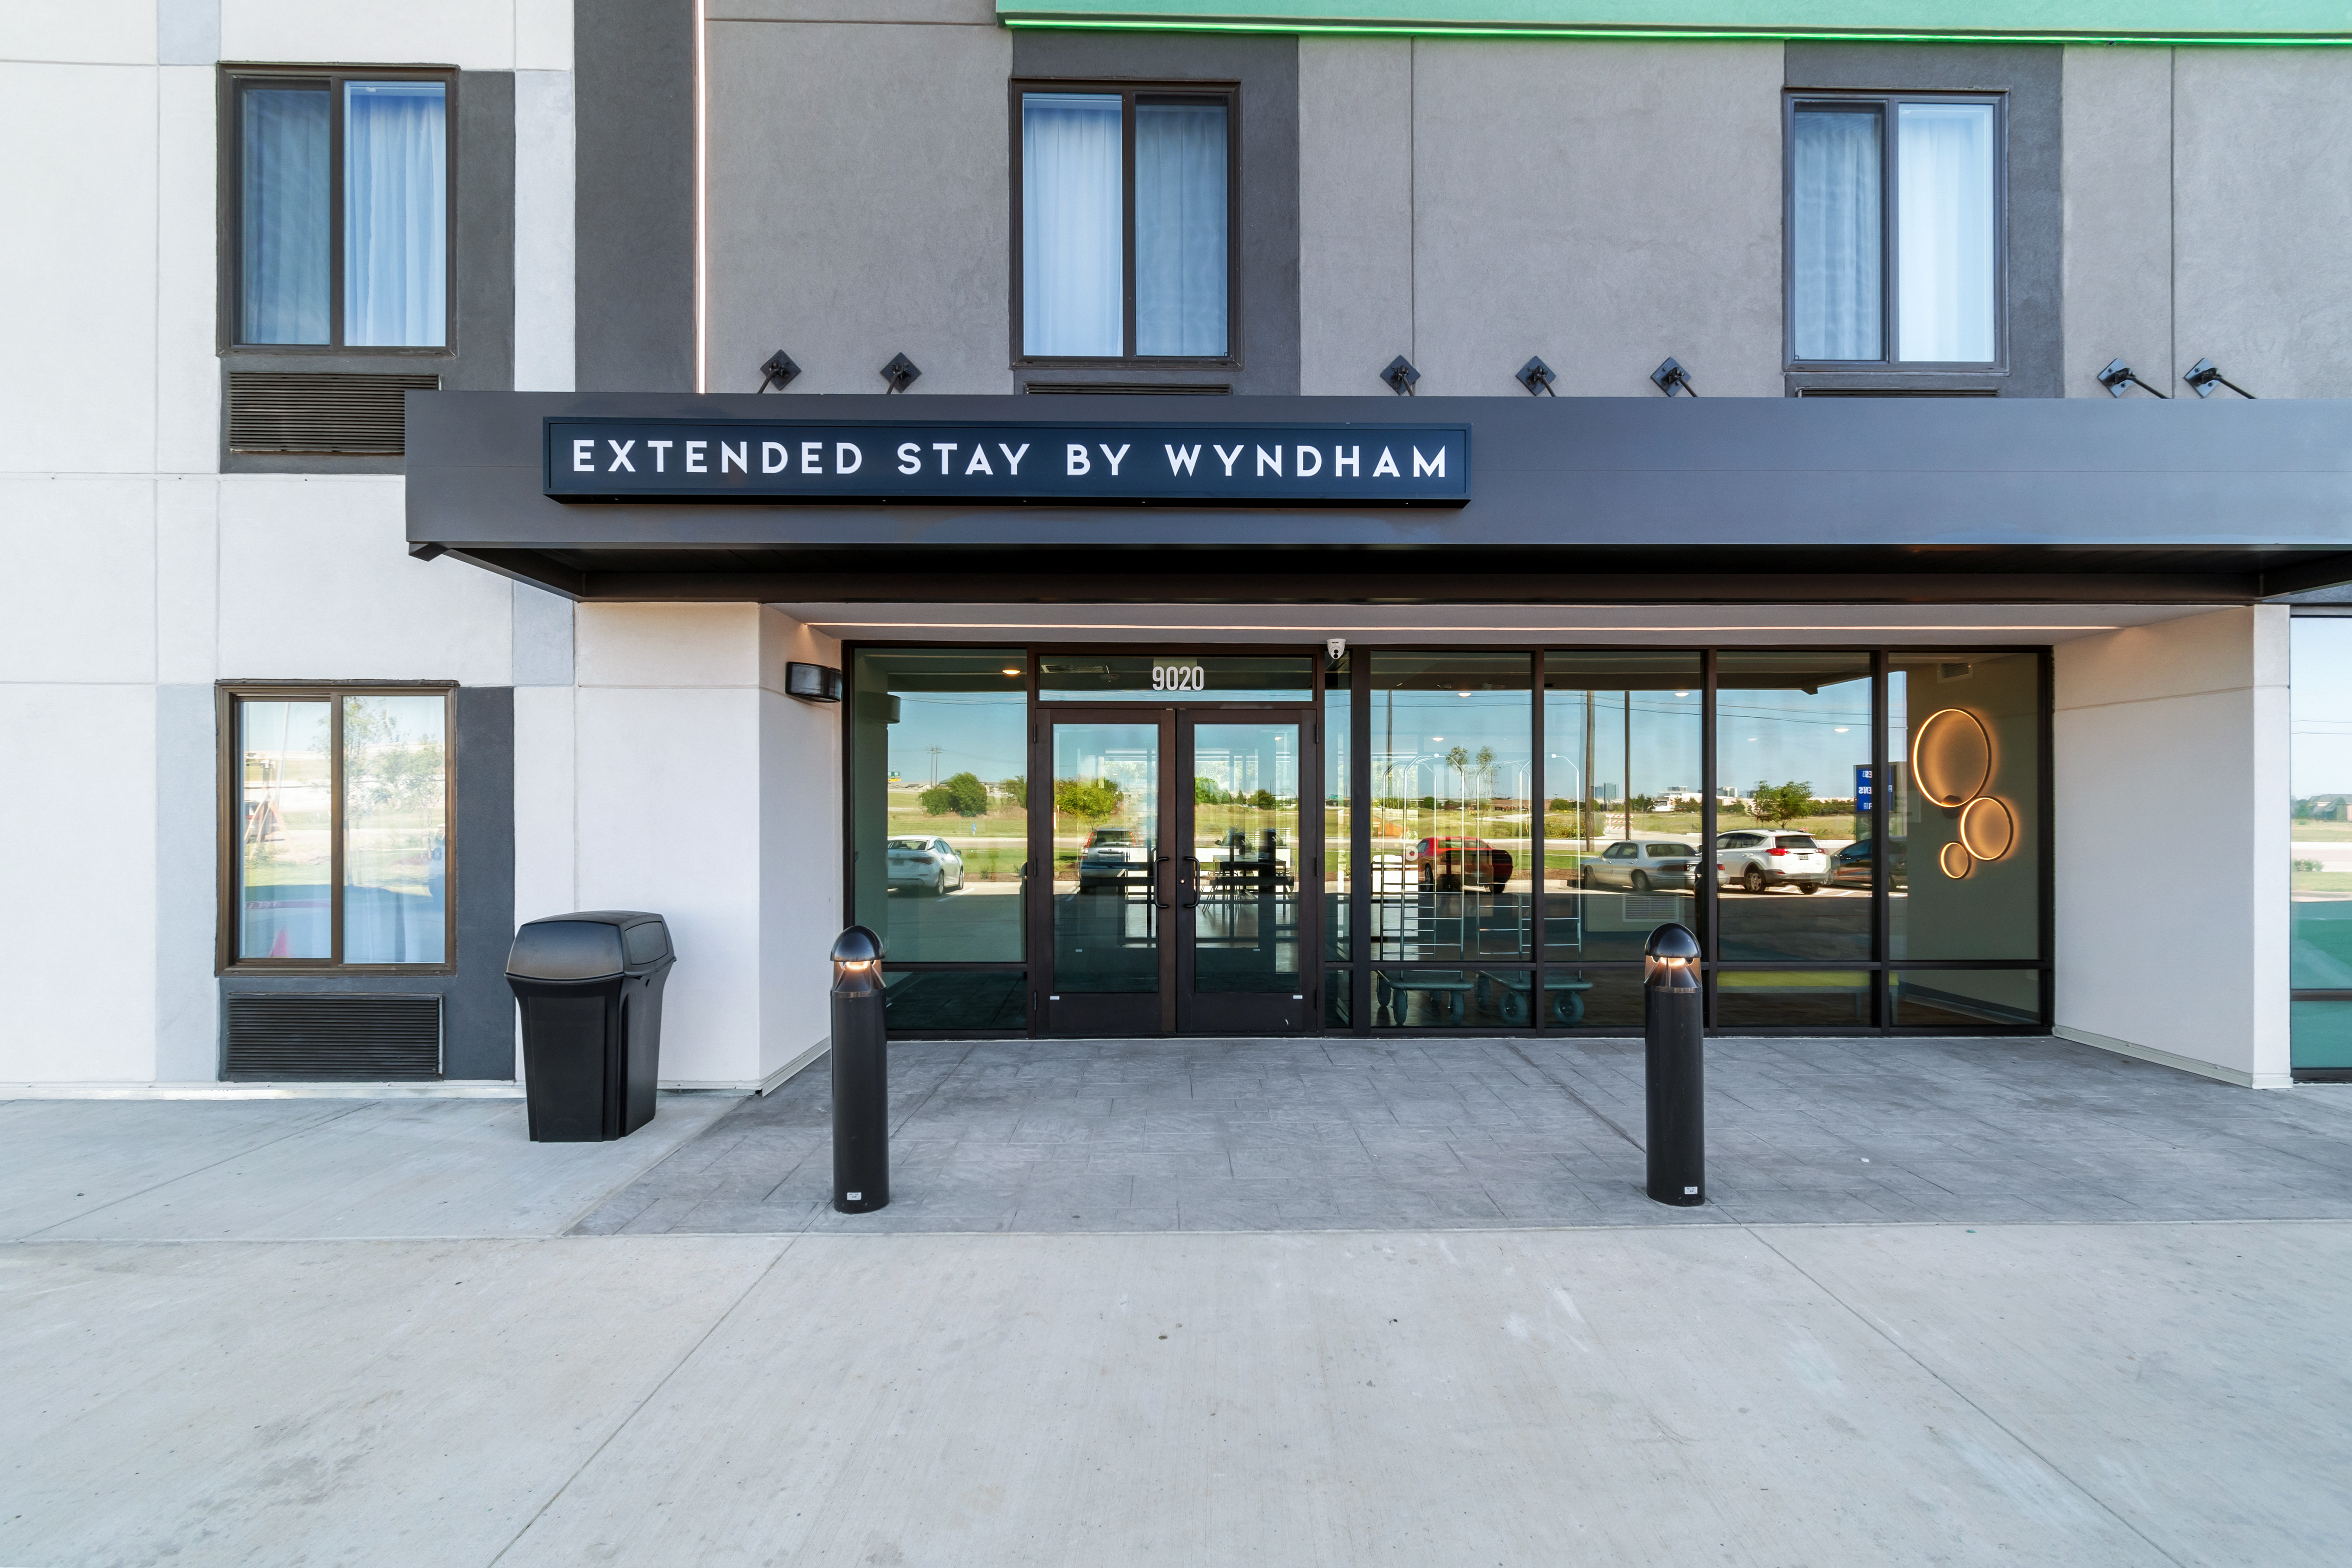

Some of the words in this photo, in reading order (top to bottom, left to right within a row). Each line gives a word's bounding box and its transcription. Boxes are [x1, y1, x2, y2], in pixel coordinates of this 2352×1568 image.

[573, 440, 862, 474] EXTENDED
[897, 443, 1030, 475] STAY
[1067, 444, 1131, 476] BY
[1164, 444, 1445, 477] WYNDHAM
[1152, 666, 1204, 691] 9020
